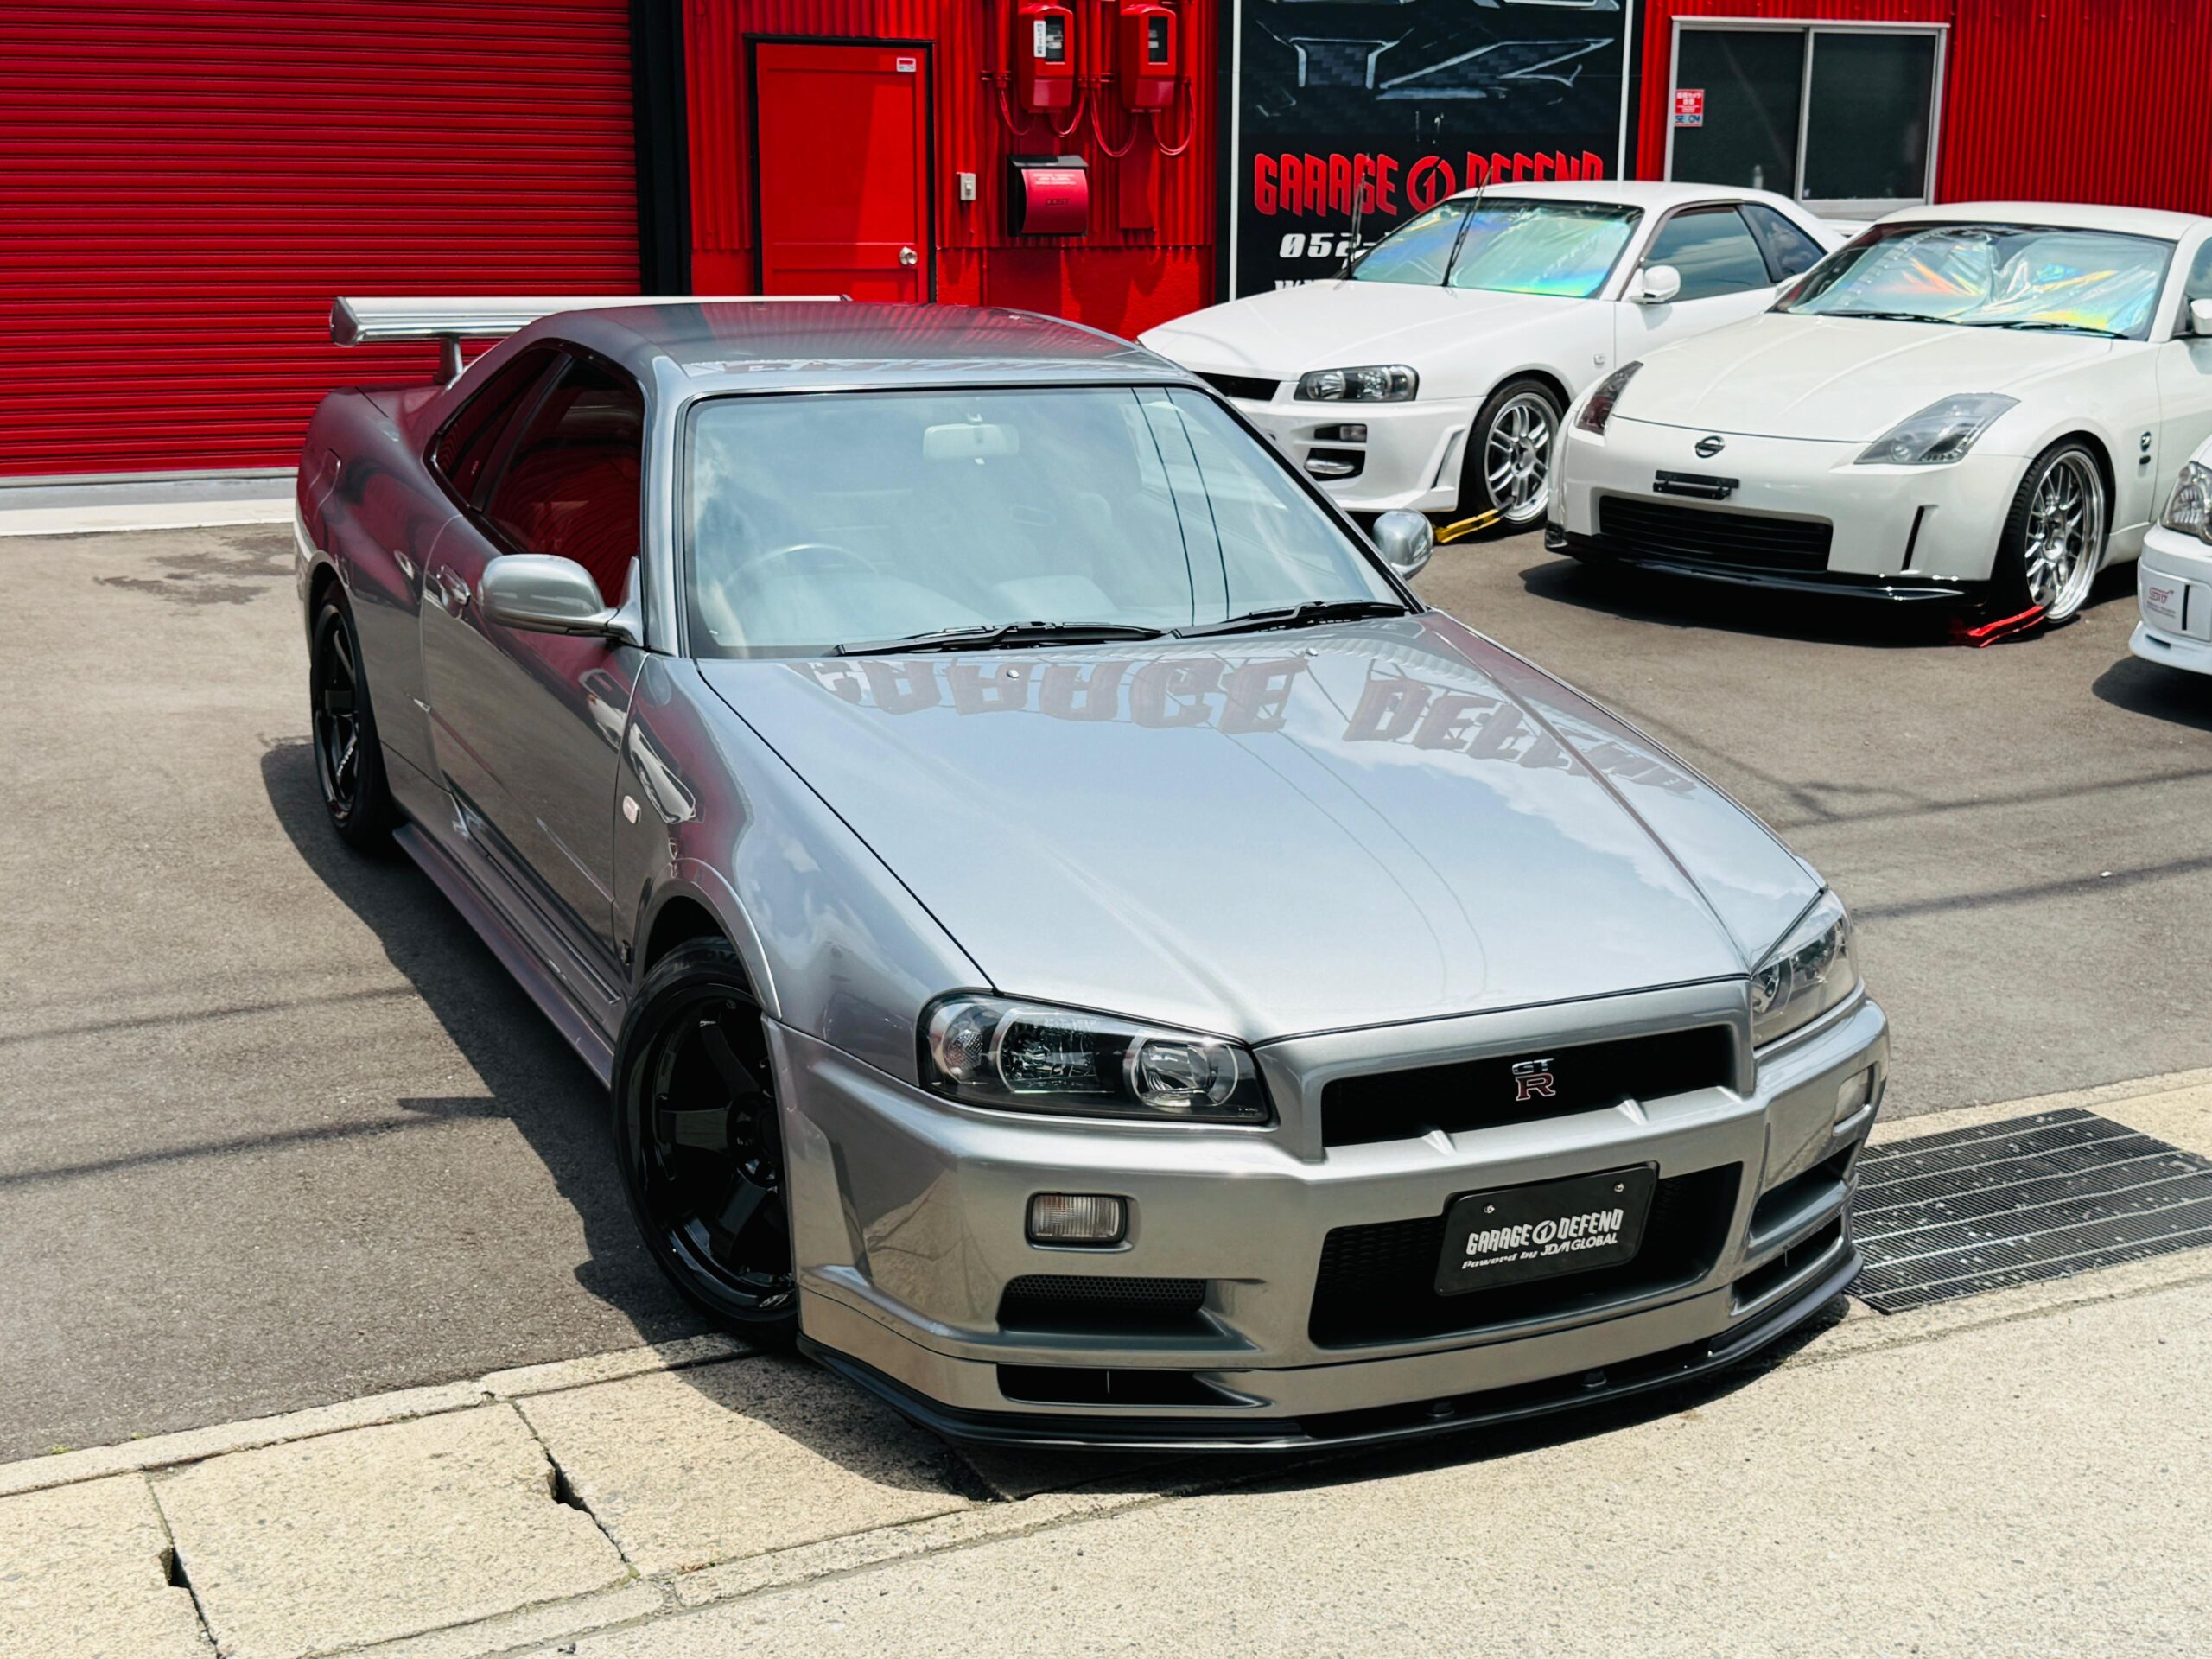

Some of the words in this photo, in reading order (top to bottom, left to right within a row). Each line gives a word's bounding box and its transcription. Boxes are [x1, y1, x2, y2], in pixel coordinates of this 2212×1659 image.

[1255, 153, 1398, 216] GARAGE
[1280, 232, 1389, 257] 052-
[1516, 1072, 1555, 1101] R
[1466, 1224, 1533, 1255] GARAGE
[1557, 1208, 1624, 1240] DEFEND
[1520, 1250, 1538, 1260] by
